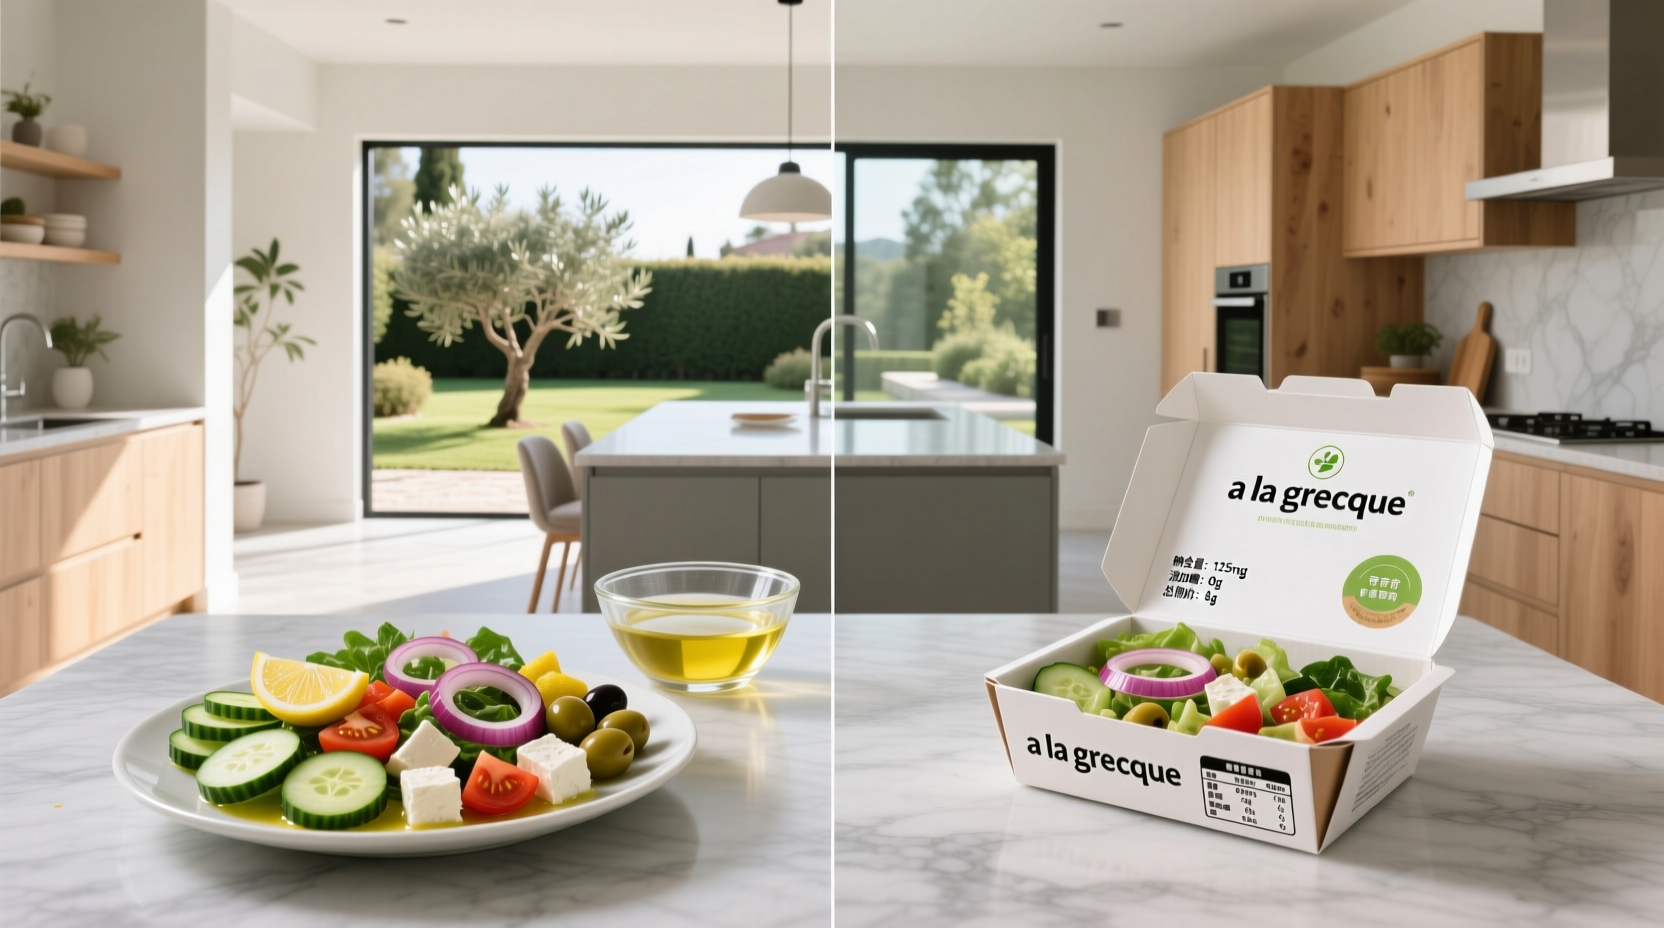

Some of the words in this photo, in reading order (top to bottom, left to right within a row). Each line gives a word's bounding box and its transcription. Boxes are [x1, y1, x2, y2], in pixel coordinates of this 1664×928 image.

[1228, 481, 1246, 500] a
[1250, 475, 1277, 503] la
[1279, 486, 1406, 520] grecque
[1027, 737, 1042, 756] a
[1045, 733, 1068, 762] la
[1073, 746, 1182, 787] grecque
